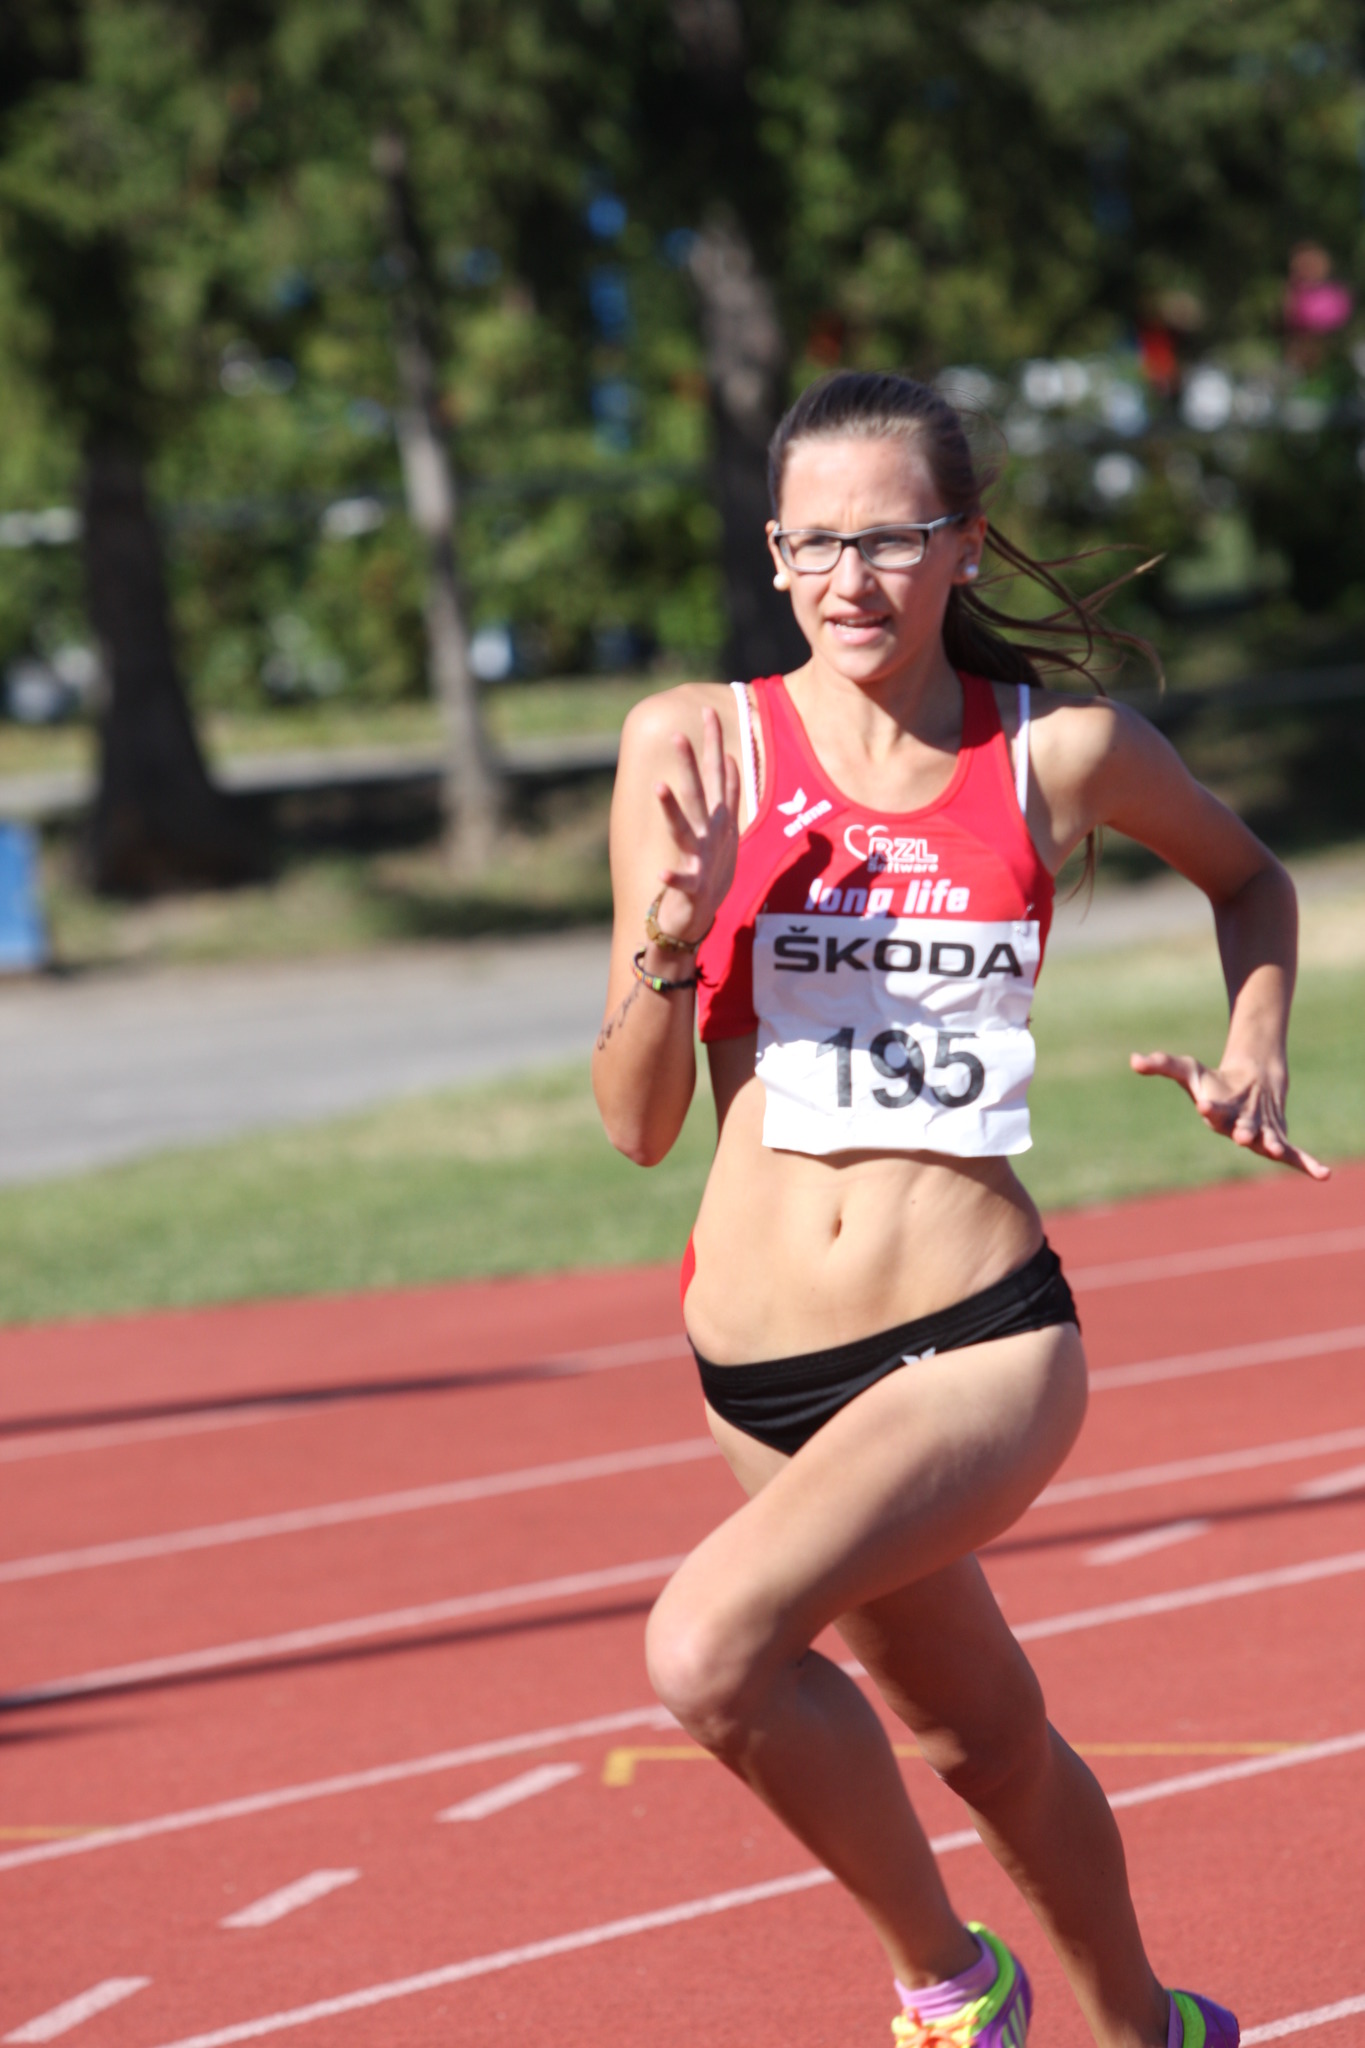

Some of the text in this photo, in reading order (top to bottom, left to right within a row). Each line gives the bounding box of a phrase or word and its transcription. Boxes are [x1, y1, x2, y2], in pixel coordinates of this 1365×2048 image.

[868, 837, 939, 863] RZL
[804, 878, 970, 920] long life
[773, 926, 1024, 979] ŠKODA
[815, 1027, 985, 1109] 195
